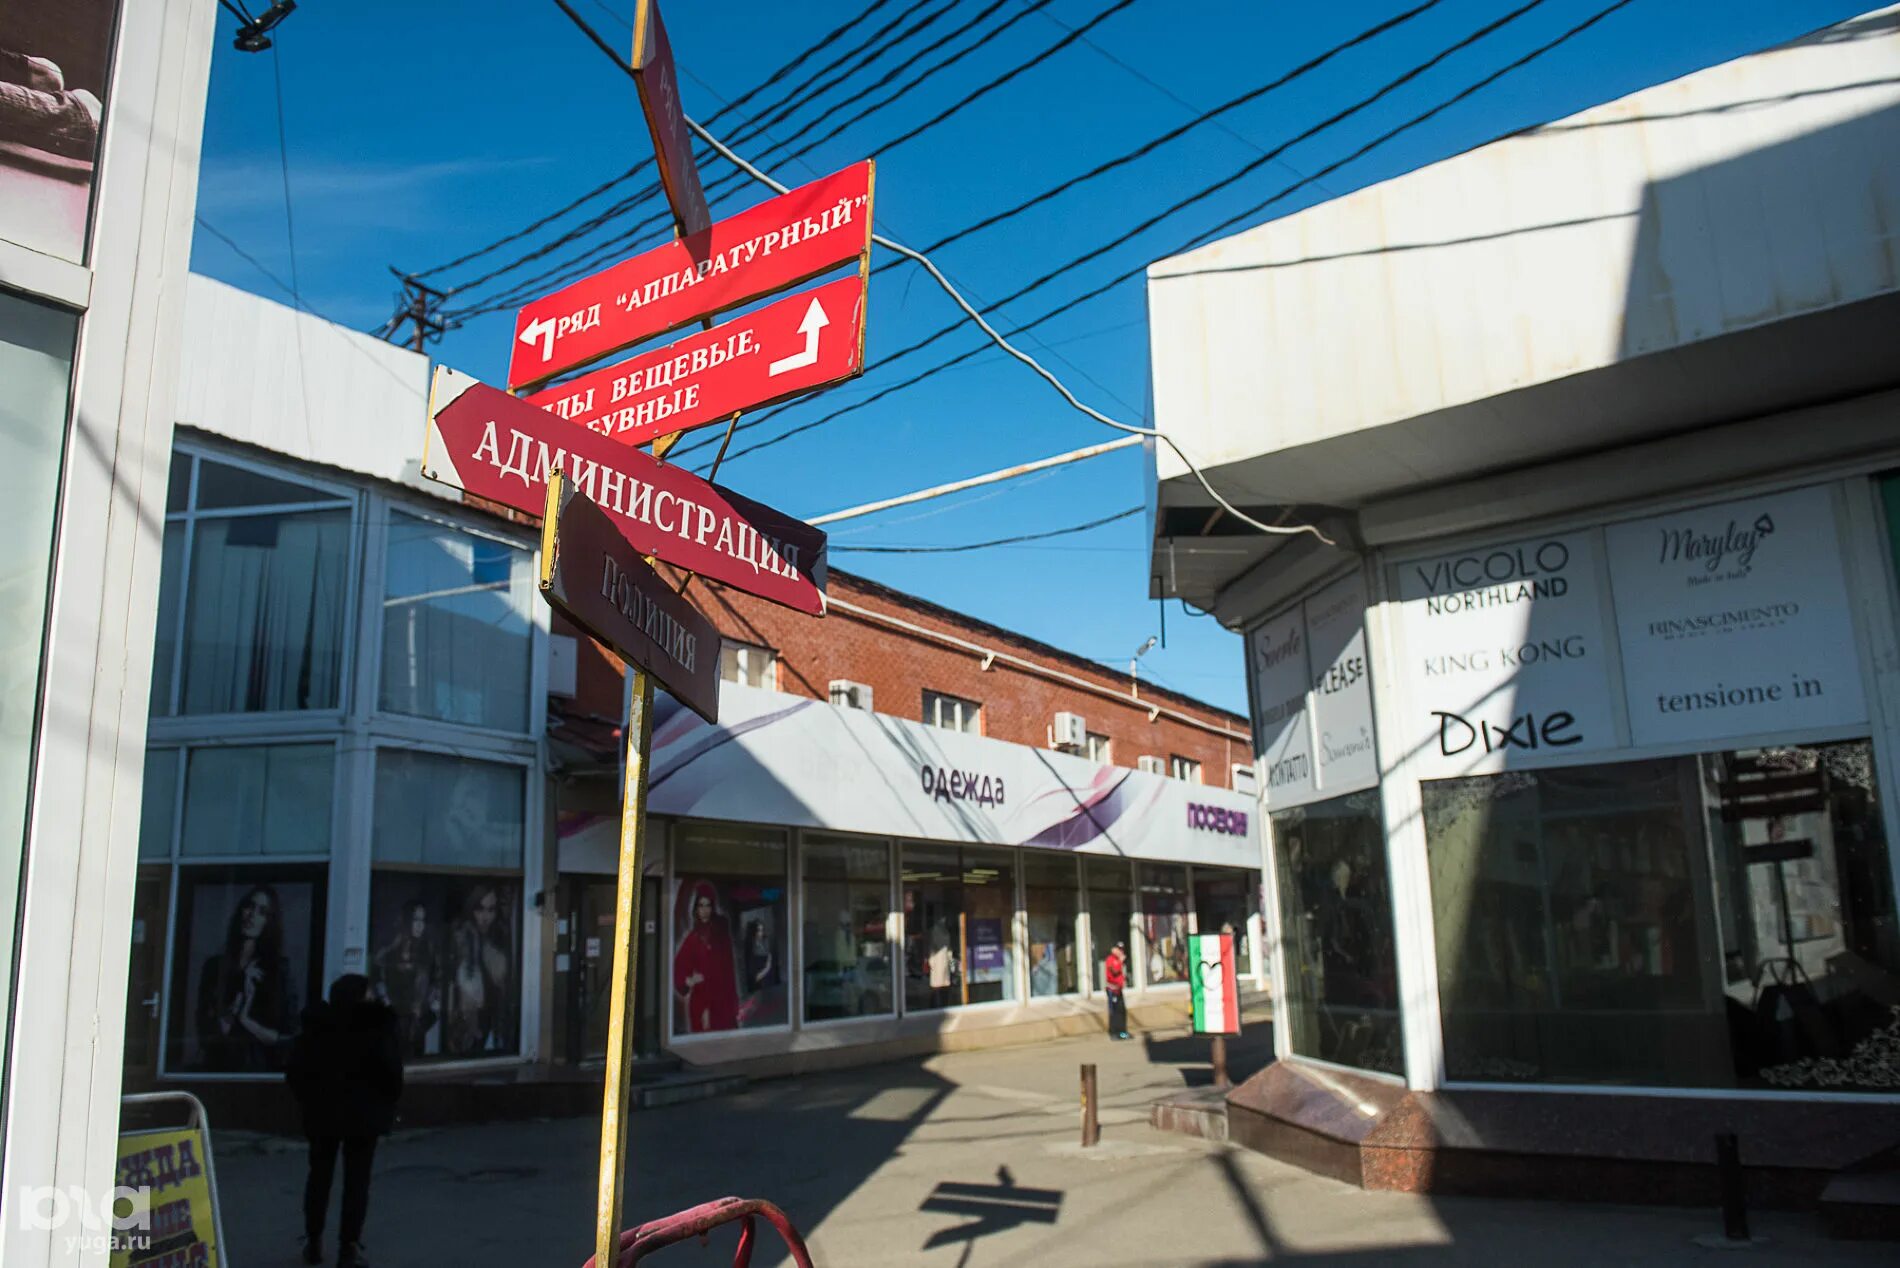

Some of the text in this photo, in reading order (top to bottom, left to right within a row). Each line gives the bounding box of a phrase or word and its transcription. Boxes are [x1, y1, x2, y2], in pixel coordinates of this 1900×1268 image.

[556, 303, 600, 339] РЯД
[542, 328, 761, 421] ДЫ ВЕЩЕВЫЕ,
[472, 420, 801, 582] АДМИНИСТРАЦИЯ
[1416, 541, 1569, 592] VICOLO
[601, 553, 697, 675] ПОЛИЦИЯ
[1427, 577, 1568, 616] NORTHLAND
[1648, 601, 1800, 636] RINASCIMENTO
[1315, 656, 1364, 695] PLEASE
[1424, 635, 1586, 677] KING KONG
[1657, 673, 1824, 714] tensione in
[921, 764, 1005, 809] одежда
[118, 1139, 201, 1195] ЖДА
